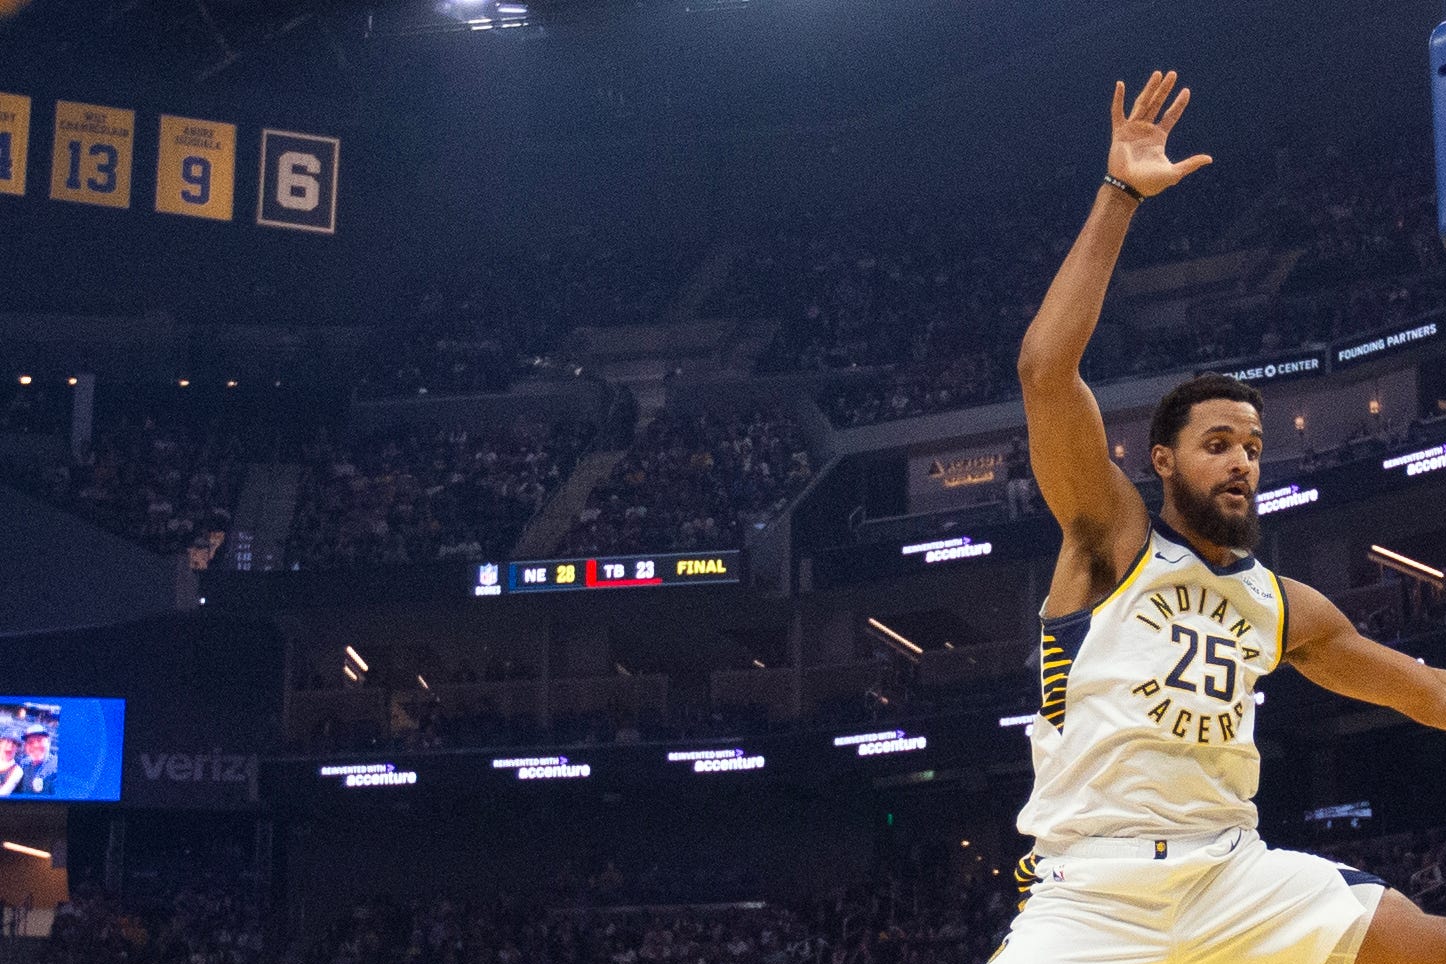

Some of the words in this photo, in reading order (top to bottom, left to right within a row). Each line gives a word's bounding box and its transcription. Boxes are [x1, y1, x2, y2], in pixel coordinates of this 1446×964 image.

[65, 141, 118, 193] 13
[180, 156, 212, 205] 9
[276, 151, 321, 211] 6
[1338, 341, 1385, 361] FOUNDING
[1386, 323, 1437, 347] PARTNERS
[1277, 358, 1319, 375] CENTER
[1420, 446, 1443, 457] WITH
[1257, 488, 1318, 515] accenture
[944, 538, 963, 548] WITH
[925, 542, 992, 563] accenture
[524, 567, 546, 583] NE
[556, 565, 576, 583] 28
[604, 564, 625, 578] TB
[636, 561, 655, 579] 23
[676, 559, 727, 575] FINAL
[1136, 585, 1260, 661] INDIANA
[1164, 623, 1237, 702] 25
[877, 731, 897, 740] WITH
[714, 750, 735, 759] WITH
[858, 736, 927, 756] accenture
[366, 764, 386, 773] WITH
[539, 757, 560, 765] WITH
[694, 755, 765, 772] accenture
[346, 771, 417, 787] accenture
[518, 764, 591, 780] accenture
